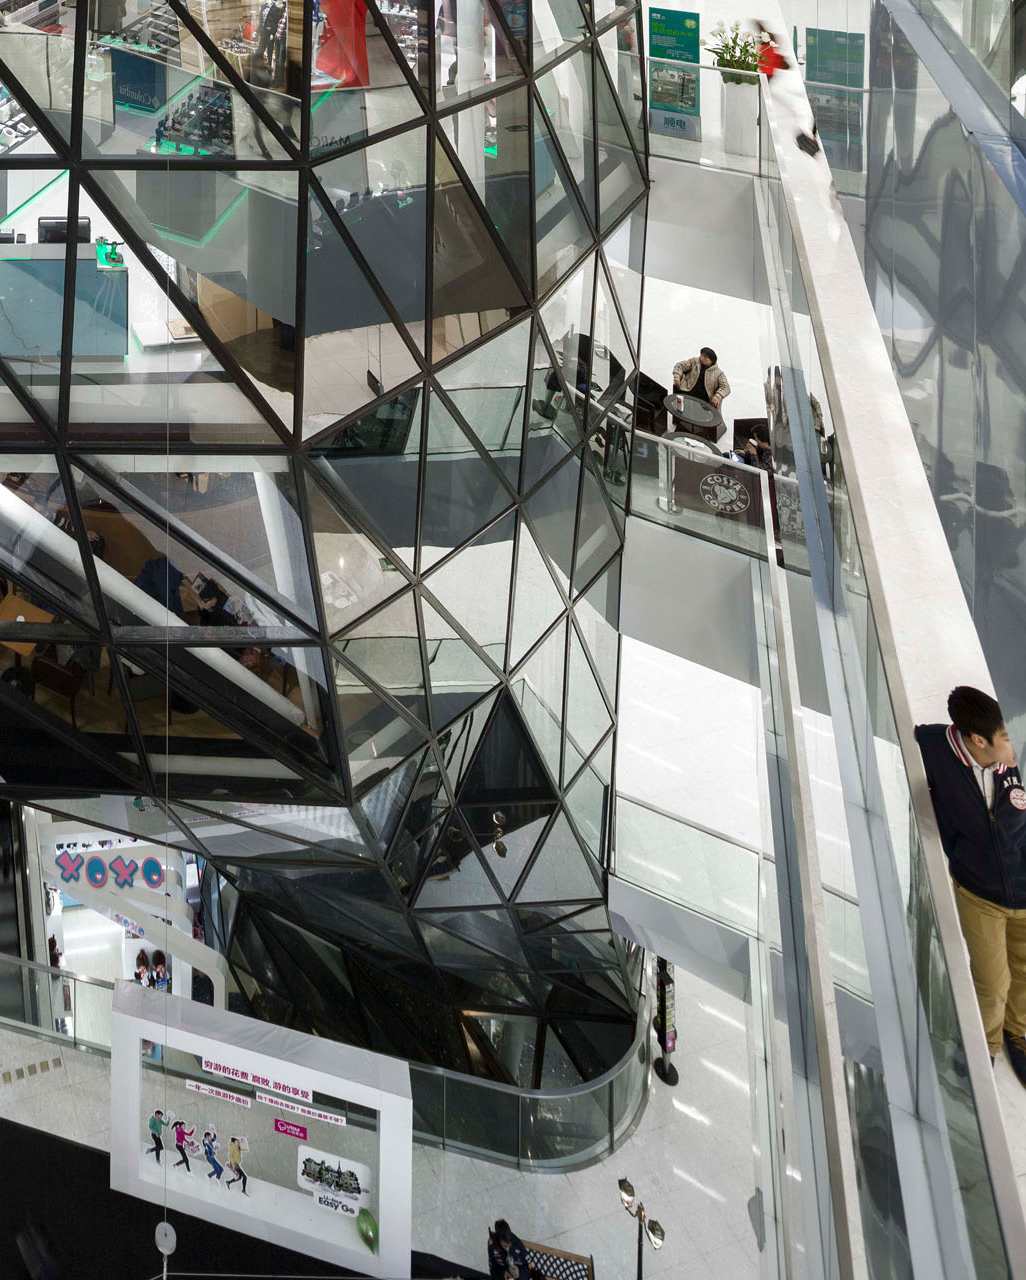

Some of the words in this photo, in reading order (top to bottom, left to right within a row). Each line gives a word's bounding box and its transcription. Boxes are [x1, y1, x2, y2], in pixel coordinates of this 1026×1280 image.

[707, 474, 741, 492] COSTA
[704, 493, 747, 513] COFFEE
[55, 849, 164, 889] XOXO
[318, 1196, 340, 1211] Easy
[341, 1204, 355, 1214] Go
